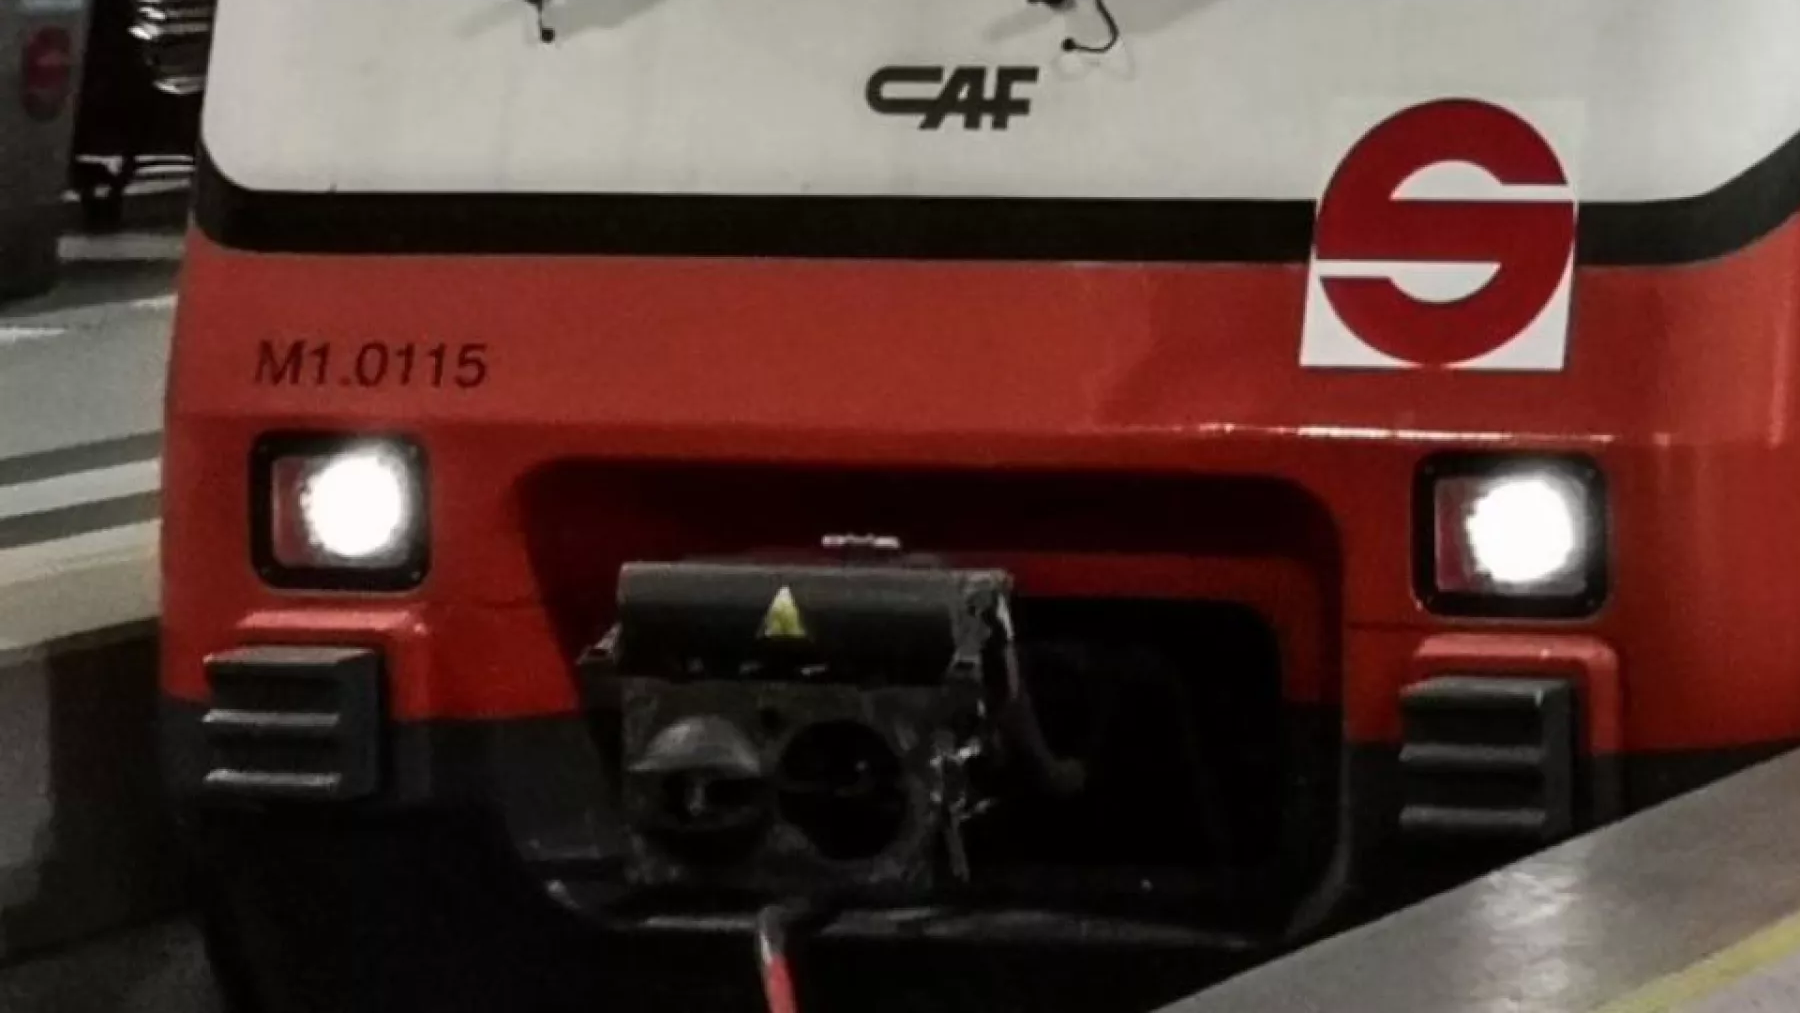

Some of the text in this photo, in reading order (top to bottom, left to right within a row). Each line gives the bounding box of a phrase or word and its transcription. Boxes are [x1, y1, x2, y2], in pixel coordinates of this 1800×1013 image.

[865, 66, 1039, 130] CAF
[1314, 96, 1576, 367] S
[254, 340, 488, 387] M1.0115
